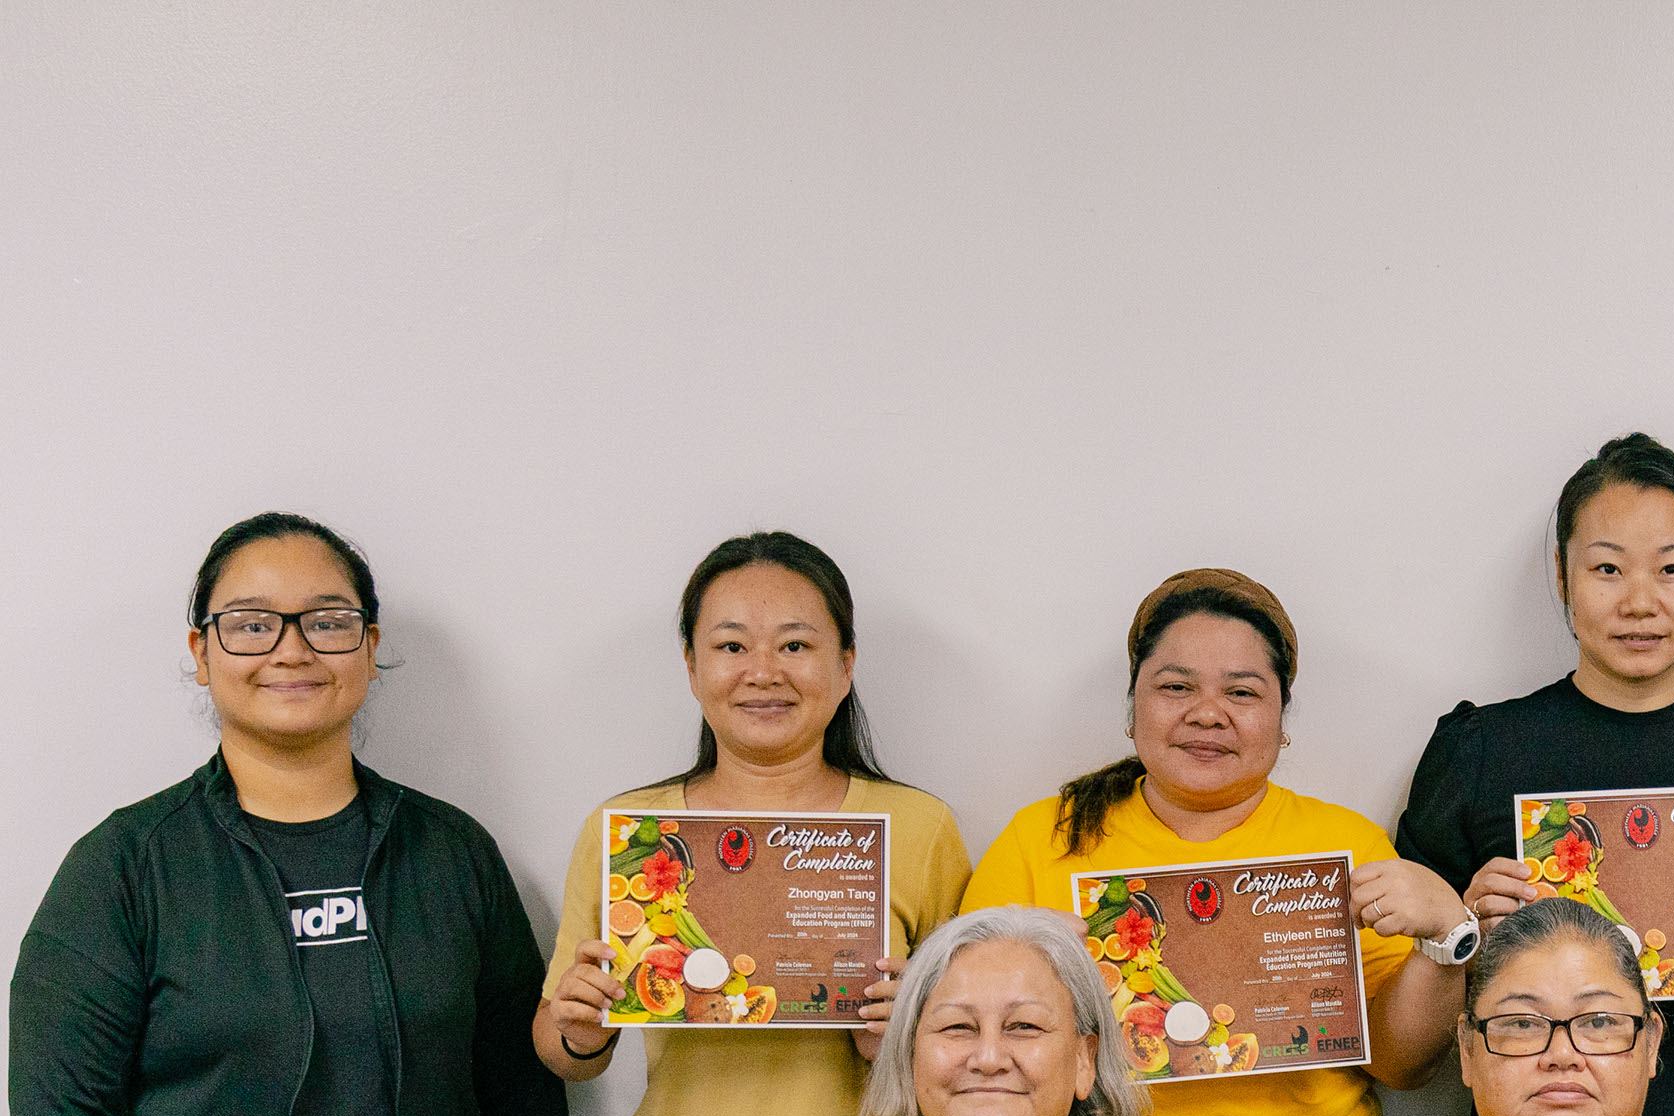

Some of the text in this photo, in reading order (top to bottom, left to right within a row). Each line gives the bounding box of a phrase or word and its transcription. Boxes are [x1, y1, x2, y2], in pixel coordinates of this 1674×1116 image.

[767, 824, 875, 853] Certificate of
[783, 847, 875, 873] Completion
[1233, 867, 1340, 896] Certificate of
[788, 888, 875, 901] Zhongyan Tang
[1251, 891, 1342, 916] Completion
[786, 911, 816, 919] Expanded
[1314, 912, 1336, 920] awarded
[823, 919, 849, 928] Program
[850, 919, 875, 927] (EFNEP)
[1263, 925, 1345, 945] Ethyleen Elnas
[1259, 954, 1289, 964] Expanded
[1306, 951, 1318, 959] and
[1319, 949, 1346, 958] Nutrition
[1266, 956, 1348, 971] Education Program (EFNEP)
[835, 999, 859, 1012] EFN
[1316, 1036, 1359, 1053] EFNEP
